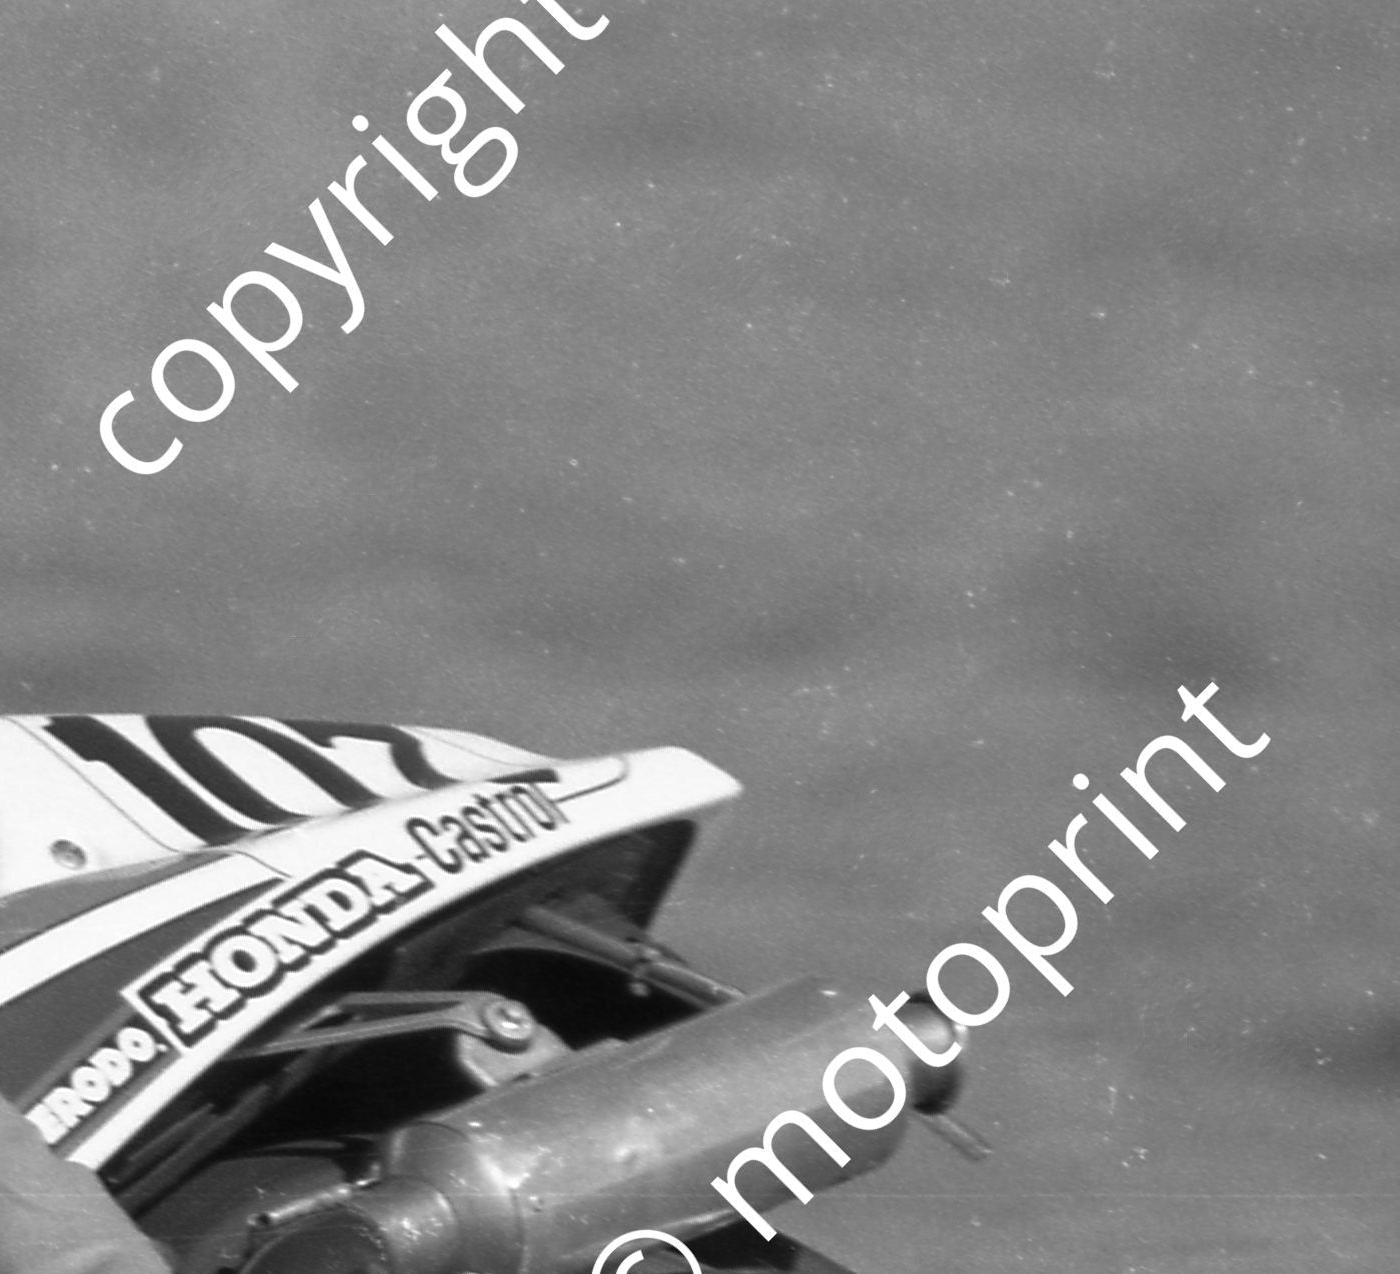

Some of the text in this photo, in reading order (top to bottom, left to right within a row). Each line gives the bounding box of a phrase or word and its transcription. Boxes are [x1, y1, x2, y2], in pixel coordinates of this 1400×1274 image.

[44, 714, 559, 848] 107
[27, 1025, 160, 1144] ERODO
[140, 851, 434, 1045] HONDA
[406, 781, 570, 873] Castrol
